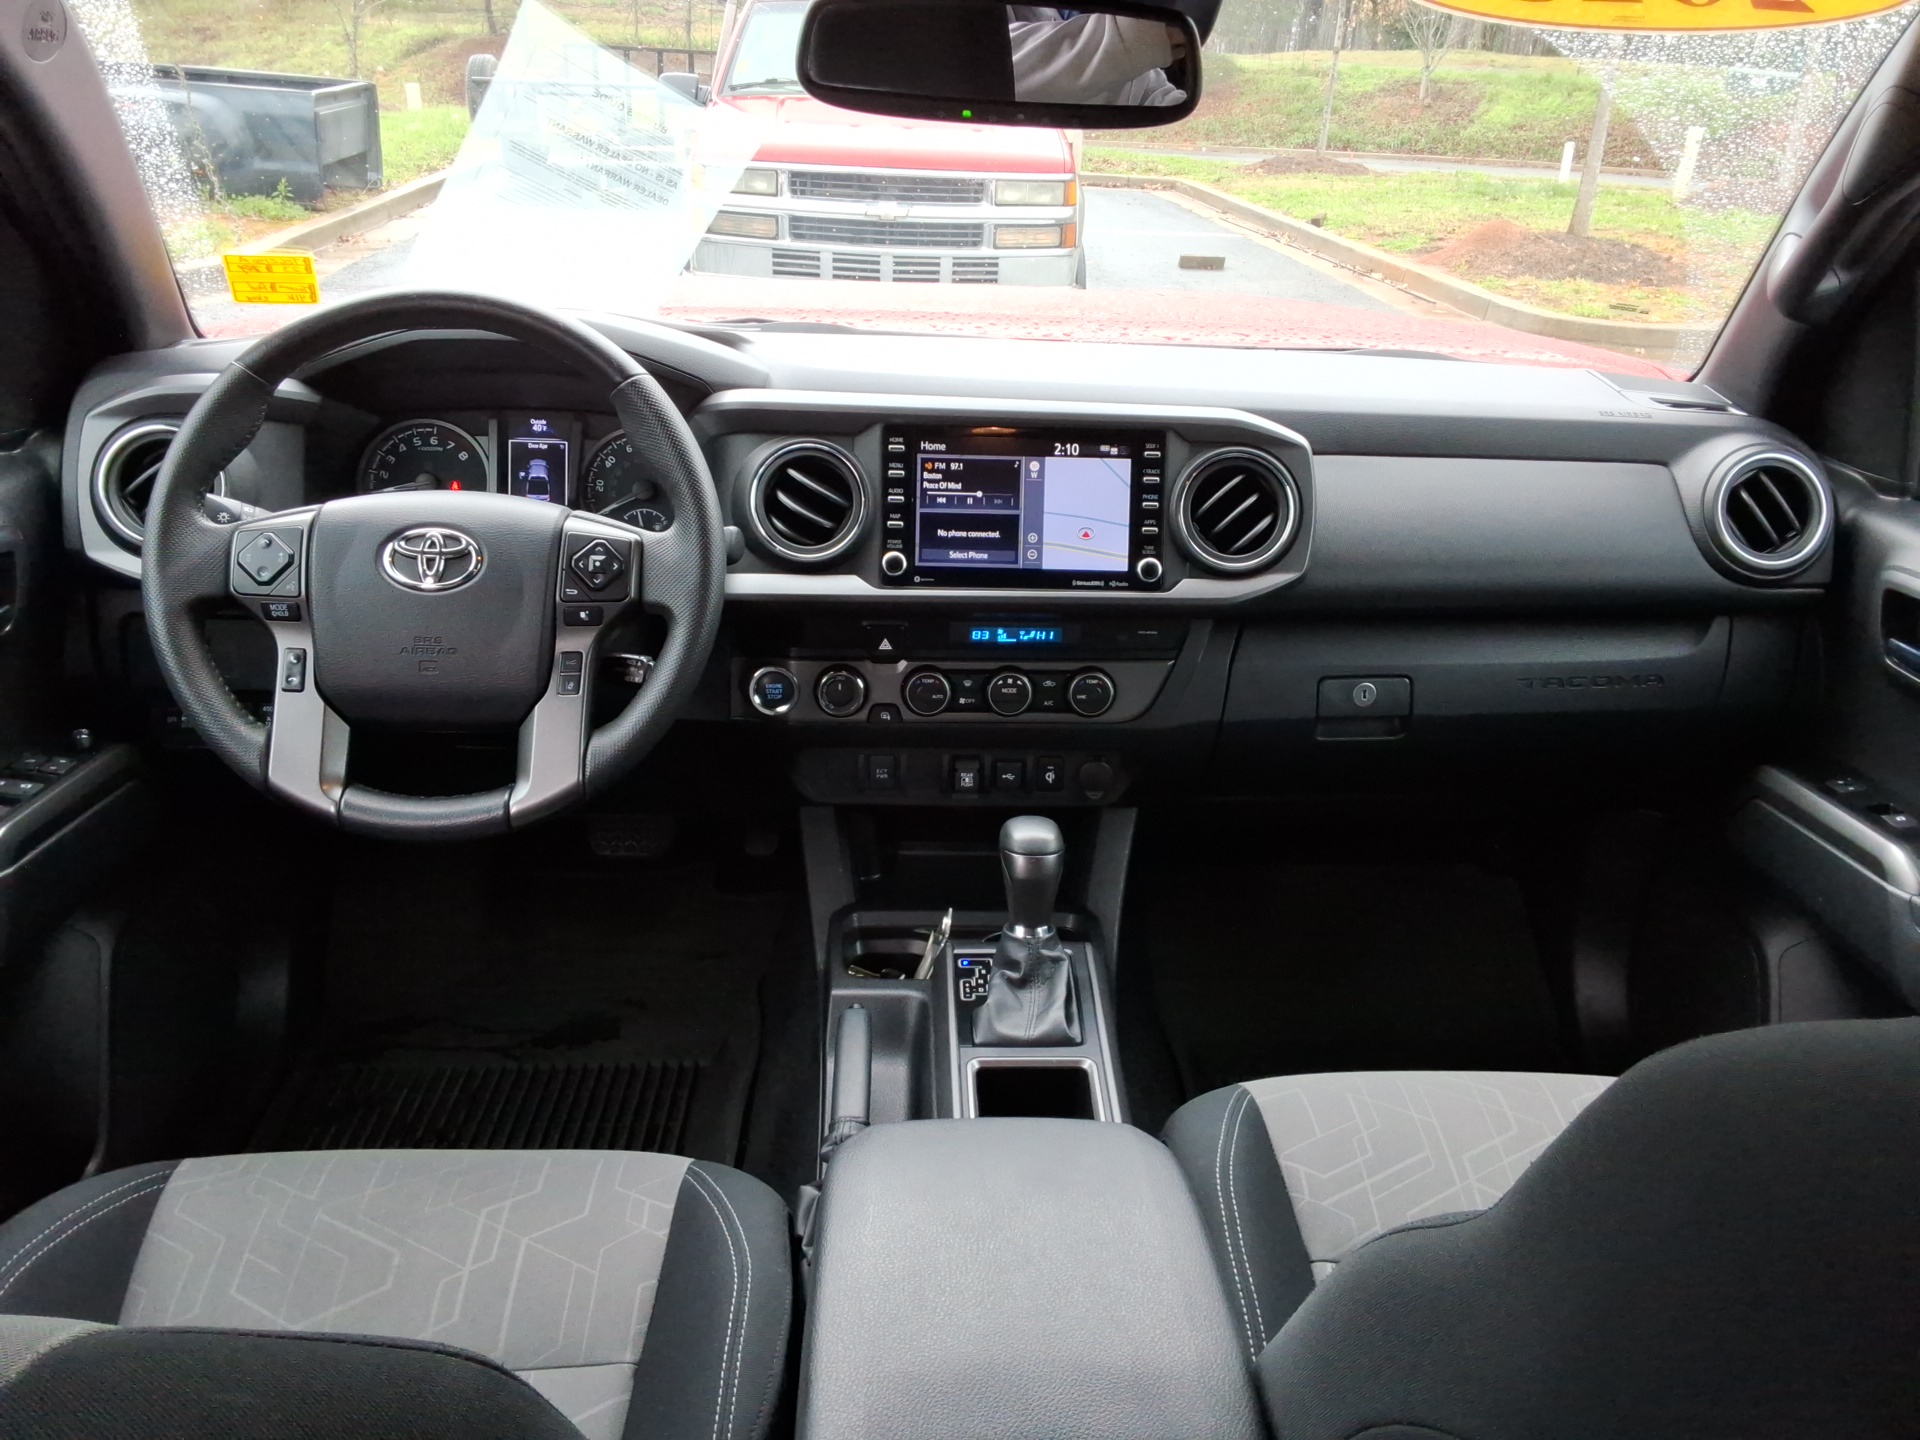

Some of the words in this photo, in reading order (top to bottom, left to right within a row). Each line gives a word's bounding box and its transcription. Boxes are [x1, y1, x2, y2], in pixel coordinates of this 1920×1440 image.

[413, 436, 422, 446] 5
[430, 436, 438, 445] 6
[399, 443, 407, 452] 4
[920, 441, 946, 451] Home
[1054, 442, 1080, 456] 2:10
[385, 454, 396, 464] 3
[458, 451, 469, 461] 8
[604, 455, 616, 468] 40
[934, 462, 946, 470] FM
[950, 462, 964, 470] 97.1
[379, 470, 389, 479] 2
[923, 471, 942, 480] Boston
[595, 479, 604, 492] 20
[923, 480, 939, 489] Peace
[939, 481, 947, 490] Of
[947, 481, 962, 490] Mind
[937, 528, 948, 537] No
[948, 529, 967, 538] phone
[967, 530, 1001, 538] connected.
[949, 551, 968, 559] Select
[968, 551, 988, 560] Phone
[269, 603, 288, 611] MODE
[971, 630, 990, 640] 83
[1517, 673, 1665, 690] TACOMA
